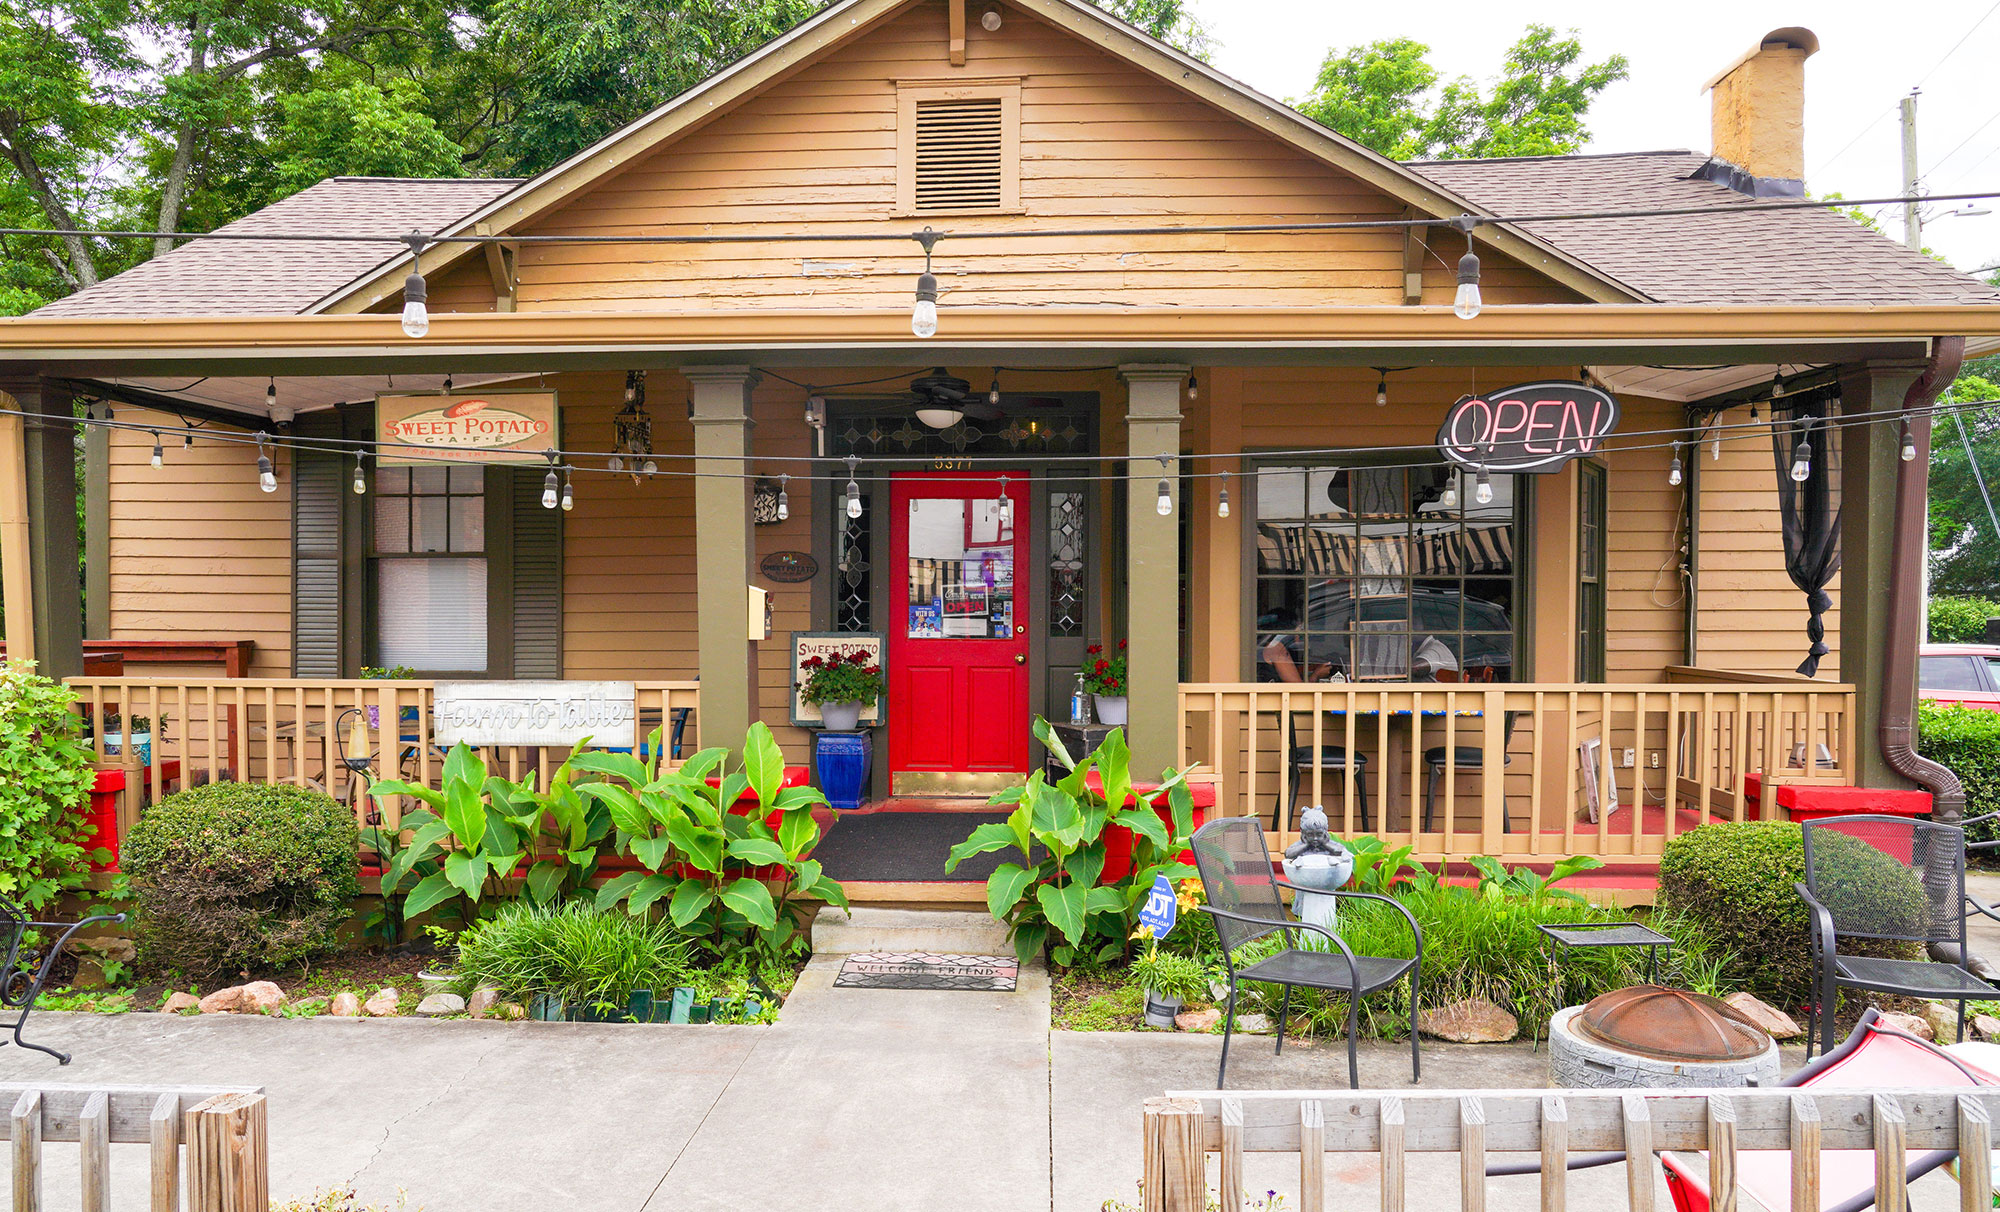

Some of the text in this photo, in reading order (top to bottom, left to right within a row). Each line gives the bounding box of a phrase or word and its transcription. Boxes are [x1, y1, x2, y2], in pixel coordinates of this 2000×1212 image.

[385, 418, 549, 437] SWEET POTATO
[1451, 400, 1601, 454] OPEN
[934, 456, 972, 470] 5377
[946, 601, 985, 613] OPEN
[799, 643, 879, 656] SWEET POTATO
[435, 698, 523, 732] Farm
[554, 692, 629, 730] Table
[1141, 891, 1173, 919] ADT
[857, 964, 930, 975] WELCOME
